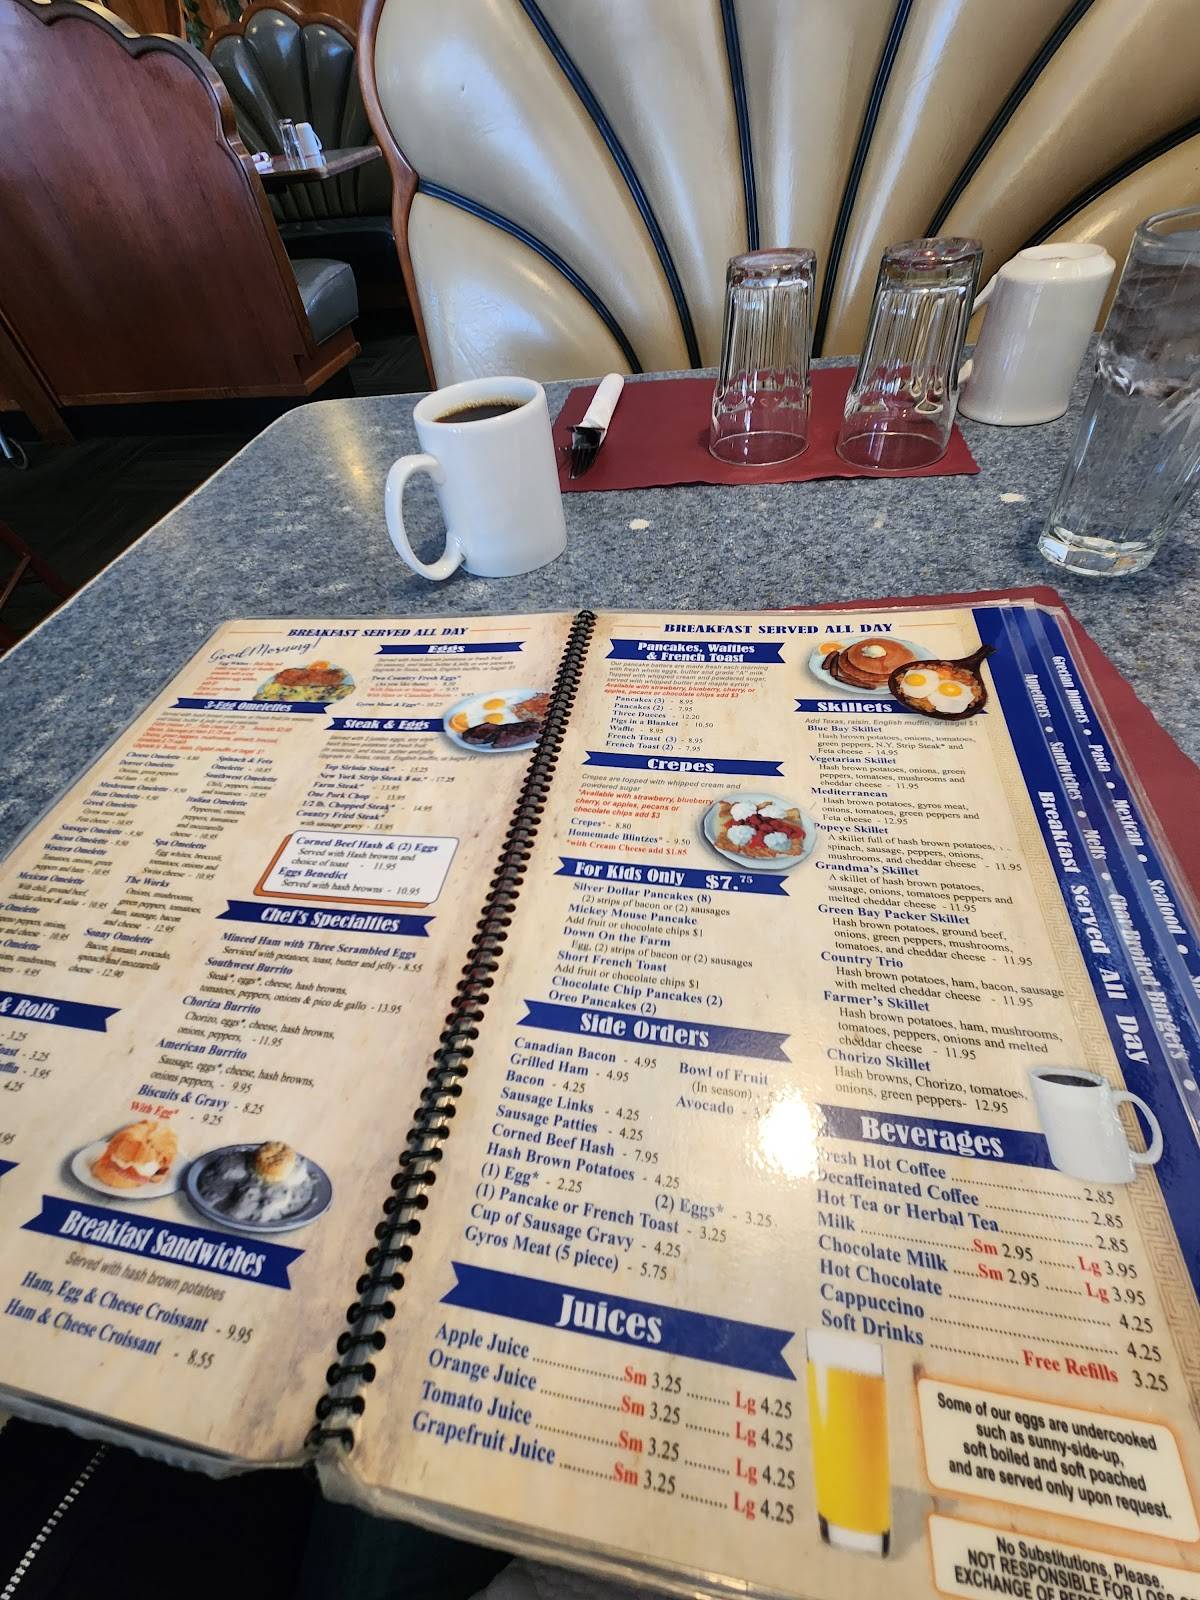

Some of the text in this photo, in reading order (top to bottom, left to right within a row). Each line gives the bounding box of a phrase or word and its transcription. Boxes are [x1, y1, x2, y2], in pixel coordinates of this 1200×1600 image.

[288, 628, 469, 637] BREAKFAST SERVED ALL DAY
[664, 623, 892, 633] BREAKFAST SERVED ALL DAY
[428, 643, 466, 654] Eggs
[637, 642, 755, 653] Pancakes, Waffles
[647, 652, 744, 662] & French Toast
[204, 701, 292, 712] 3-Egg Omelettes
[817, 702, 892, 712] Skillets
[343, 719, 430, 731] Steak & Eggs
[647, 758, 715, 773] Crepes
[810, 756, 896, 765] Vegetarian Skillet
[1025, 673, 1107, 860] Appetizers Sandwiches Melts
[811, 787, 888, 798] Mediterranean
[1052, 656, 1186, 936] Grecian Dinners Pasta Mexican Seafood
[296, 837, 439, 852] Corned Beef Hash & (2) Eggs
[568, 828, 619, 841] Homemade
[673, 838, 690, 846] 9.50
[278, 867, 347, 880] Eggs Benedict
[575, 862, 685, 885] For Kids Only
[573, 882, 712, 903] Silver Dollar Pancakes (8)
[261, 907, 400, 932] Chef's Specialties
[568, 904, 697, 926] Mickey Mouse Pancake
[818, 904, 970, 926] Green Bay Packer Skillet
[1038, 791, 1149, 1066] Breakfast Served All Day
[205, 958, 292, 975] Southwest Burrito
[820, 951, 904, 968] Country Trio
[836, 966, 1064, 998] Hash brown potatoes, ham, bacon, sausage
[824, 990, 929, 1012] Farmer's Skillet
[580, 1012, 710, 1048] Side Orders
[158, 1039, 247, 1059] American Burrito
[514, 1037, 657, 1069] Canadian Bacon 4.95
[138, 1085, 263, 1114] Biscuits & Gravy 8.25
[861, 1116, 1004, 1158] Beverages
[487, 1143, 680, 1189] Hash Brown Potatoes 4.25
[60, 1211, 266, 1277] Breakfast Sandwiches
[818, 1212, 1138, 1279] Milk Sm 2.95 Lg 3.95
[21, 1272, 252, 1343] Ham, Egg & Cheese Croissant 9.95
[819, 1260, 1153, 1333] Hot Chocolate 4.25
[556, 1294, 662, 1344] Juices
[820, 1284, 1162, 1362] Cappuccino 4.25
[821, 1309, 1168, 1392] Soft Drinks Free Refills 3.25
[435, 1324, 792, 1419] Apple Juice Sm 3.25 Lg 4.25
[938, 1392, 1157, 1450] Some of our eggs are undercooked
[976, 1424, 1124, 1466] such as sunny-side-up,
[412, 1412, 794, 1525] Grapefruit Juice Sm 3.25 Lg 4.25
[963, 1442, 1146, 1491] soft boiled and soft poached
[949, 1460, 1172, 1520] and are served only upon request.
[996, 1536, 1165, 1588] No Substitutions, Please.
